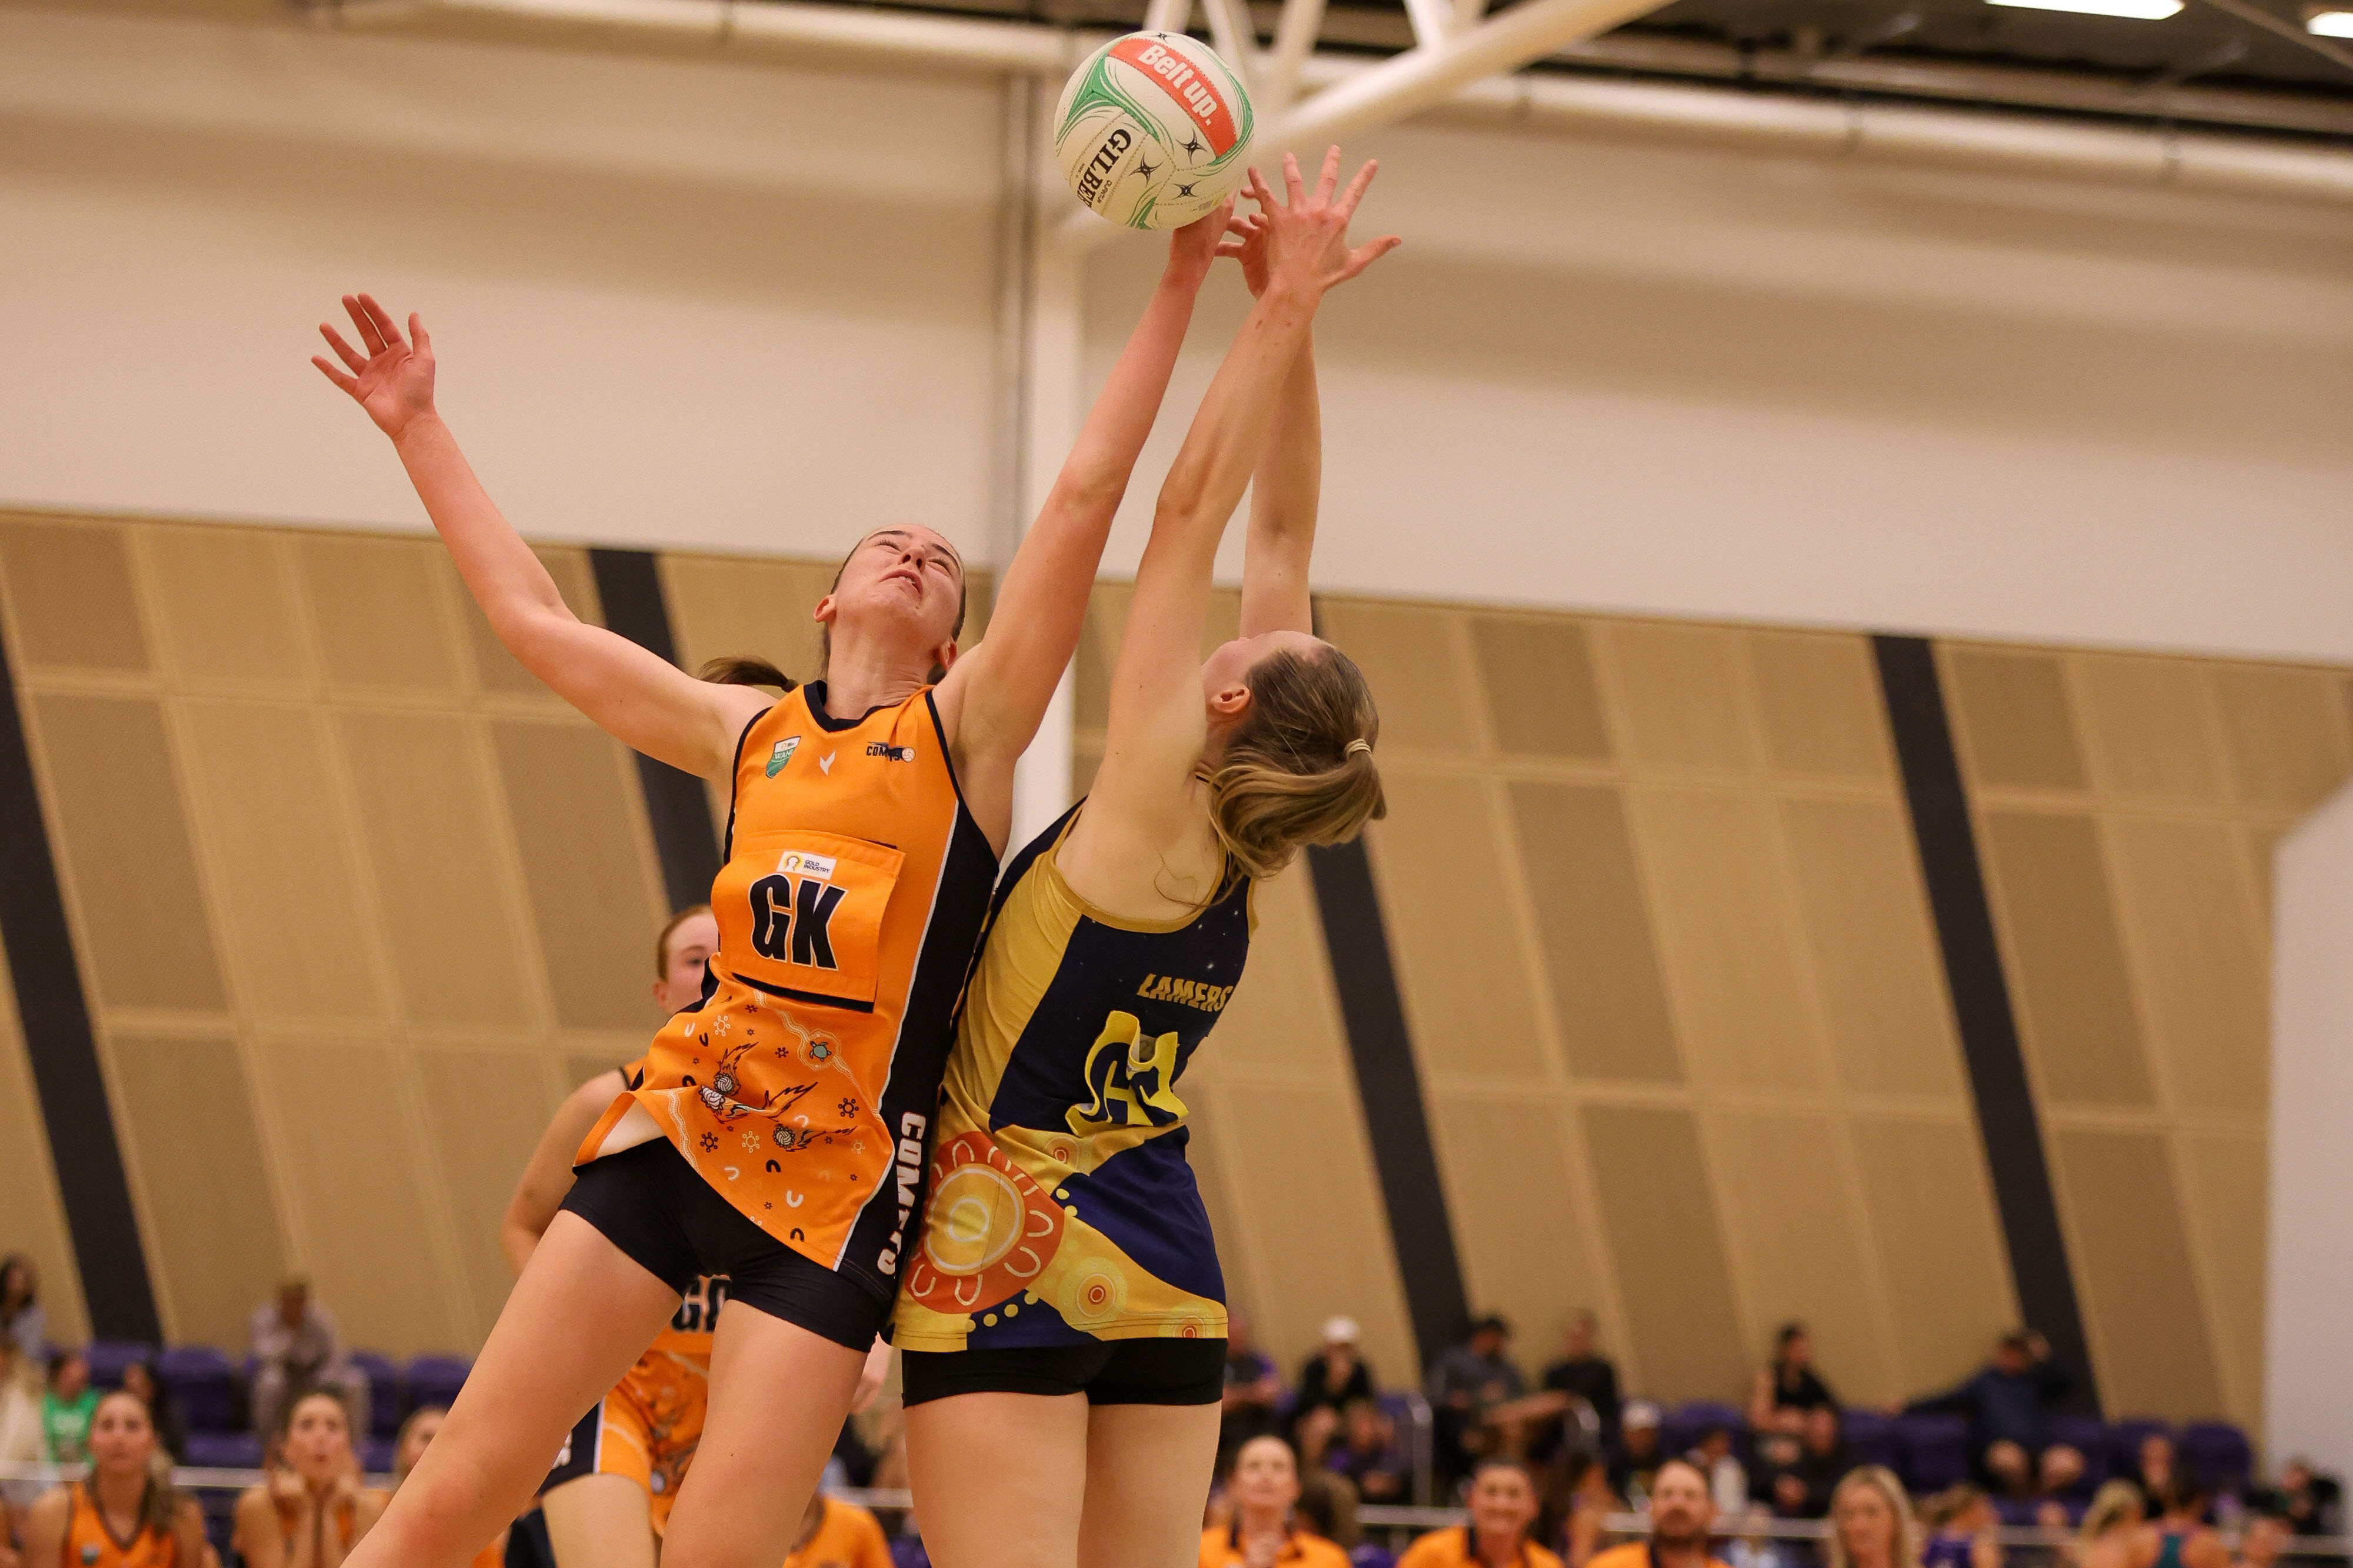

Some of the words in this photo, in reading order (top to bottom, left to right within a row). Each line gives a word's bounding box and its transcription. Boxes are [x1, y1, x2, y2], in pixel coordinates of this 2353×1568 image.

[1137, 44, 1194, 89] Belt
[1184, 80, 1217, 126] up.
[804, 864, 831, 873] INDUSTRY
[748, 873, 848, 970] GK
[1136, 973, 1234, 1012] LAMERS
